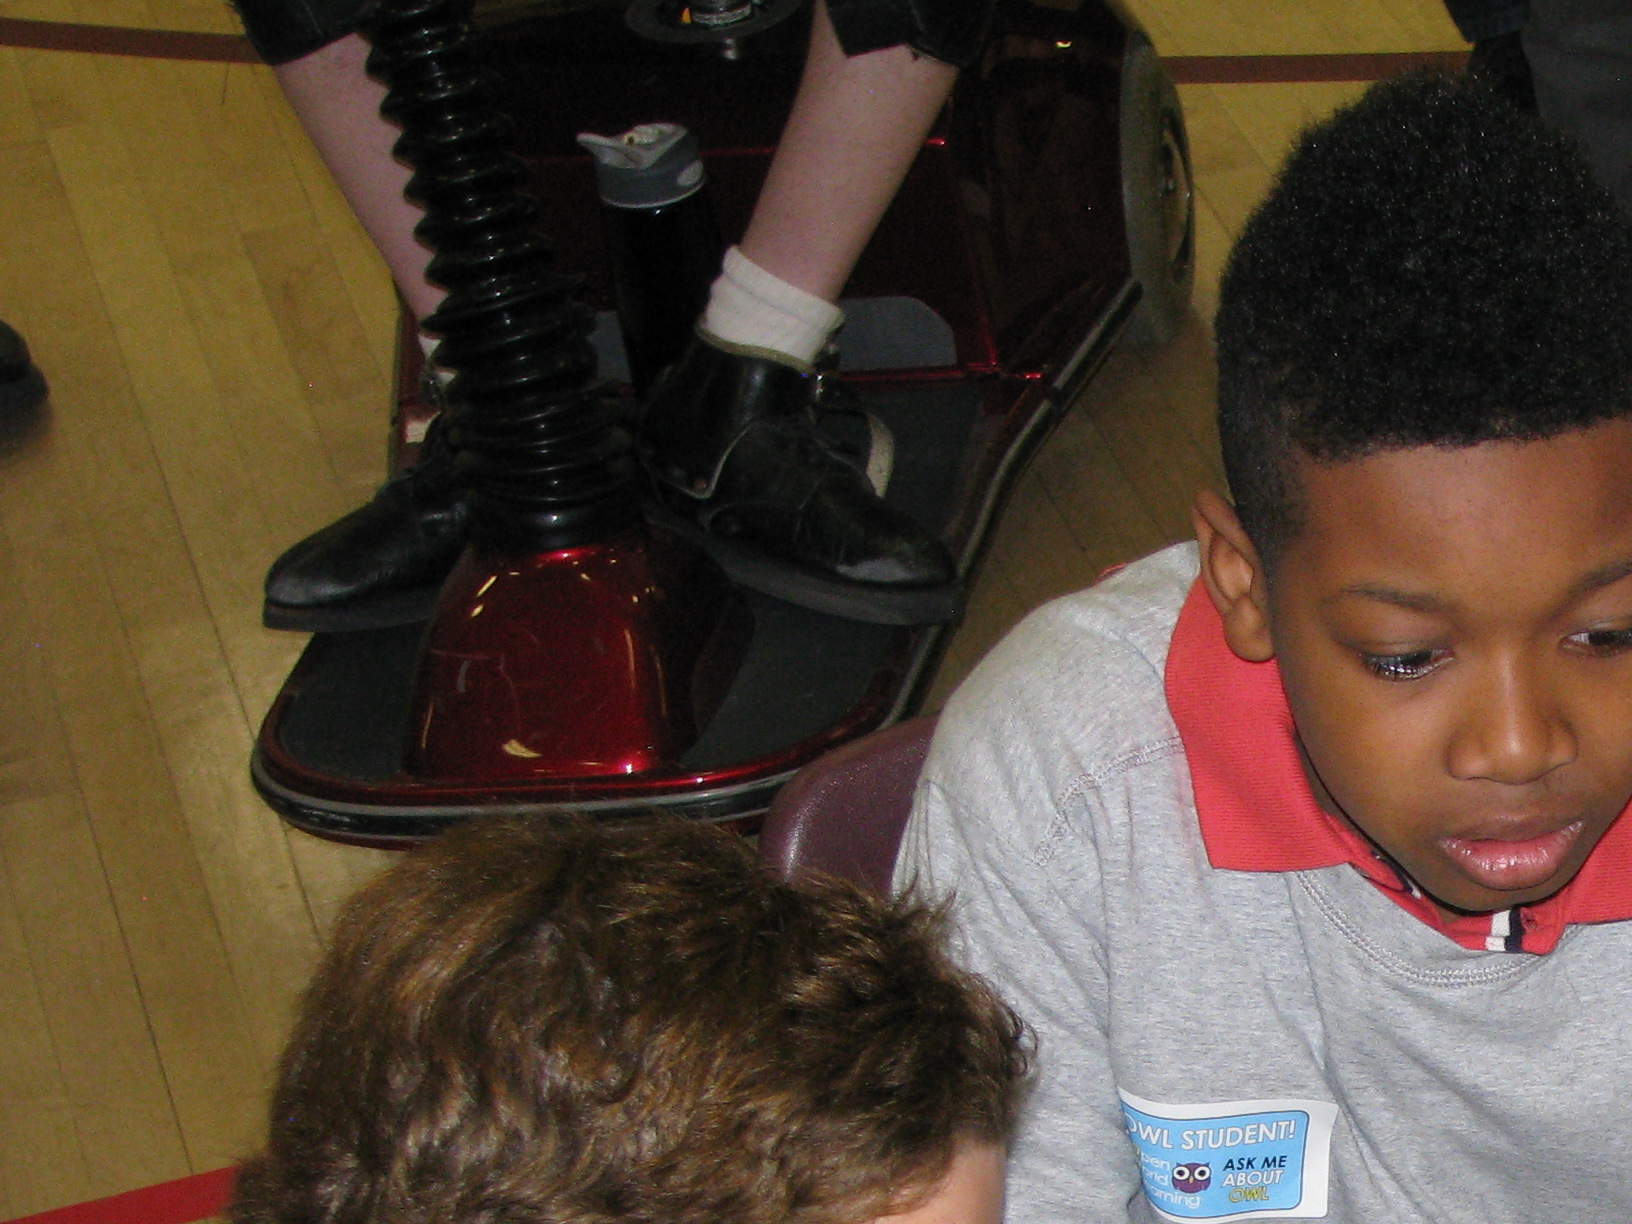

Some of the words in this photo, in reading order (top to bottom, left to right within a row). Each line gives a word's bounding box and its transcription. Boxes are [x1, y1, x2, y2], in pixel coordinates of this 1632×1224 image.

[1180, 1120, 1297, 1151] STUDENT!
[1137, 1148, 1171, 1171] pen
[1222, 1156, 1257, 1171] ASK
[1261, 1155, 1287, 1169] ME
[1221, 1169, 1285, 1188] ABOUT
[1229, 1186, 1269, 1203] OWL
